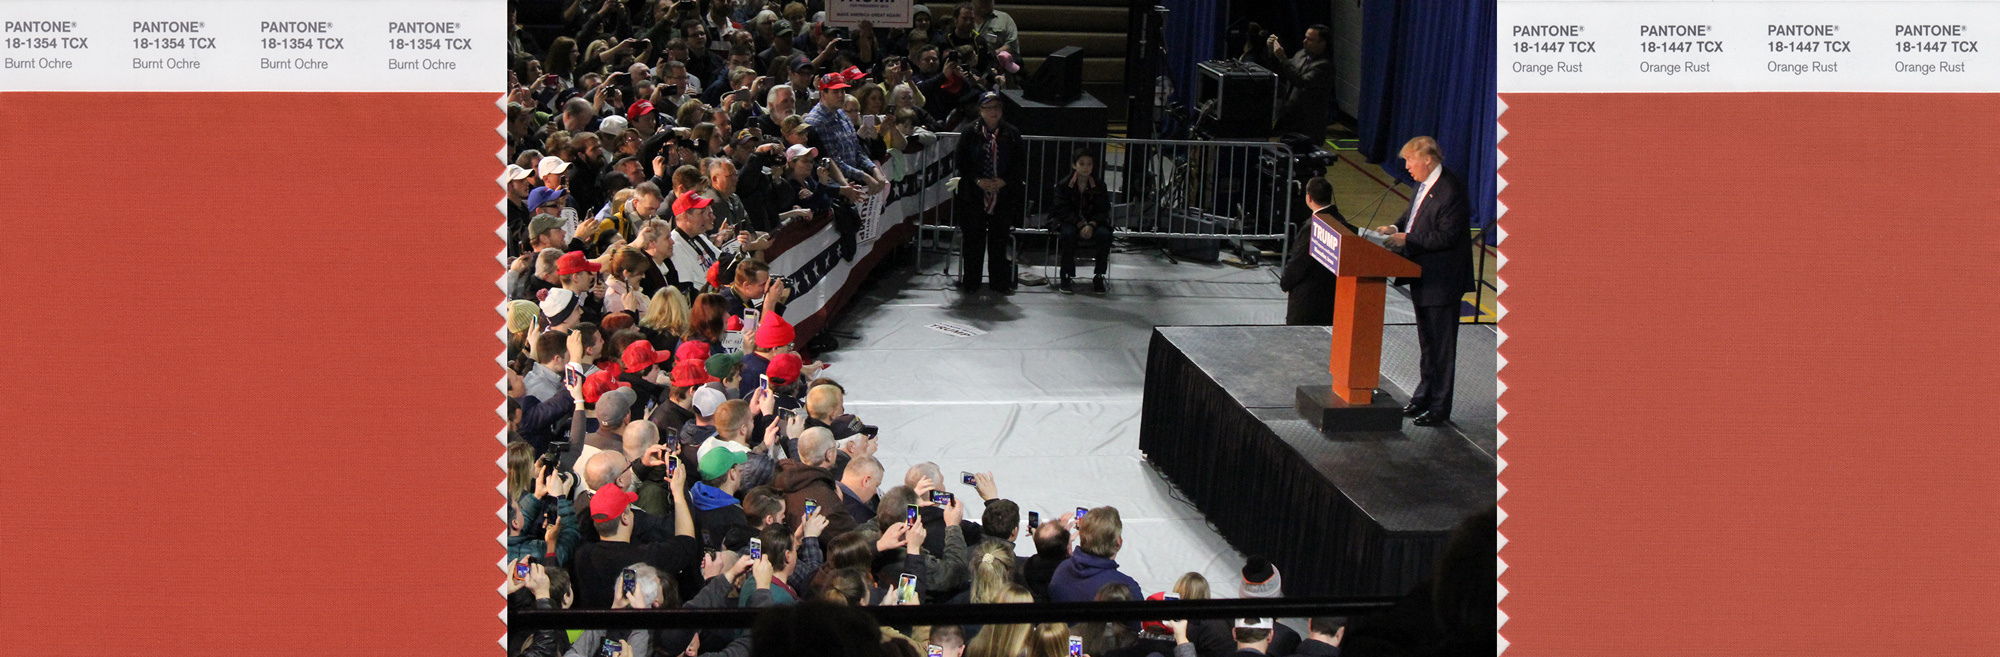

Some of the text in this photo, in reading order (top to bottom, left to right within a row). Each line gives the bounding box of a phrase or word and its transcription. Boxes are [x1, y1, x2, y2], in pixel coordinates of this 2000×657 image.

[5, 37, 88, 49] 18-1354 TCX
[133, 37, 216, 49] 18-1354 TCX
[261, 38, 344, 50] 18-1354 TCX
[389, 38, 472, 50] 18-1354 TCX
[1513, 41, 1596, 53] 18-1447 TCX
[1641, 41, 1724, 53] 18-1447 TCX
[1768, 41, 1851, 53] 18-1447 TCX
[1896, 41, 1979, 53] 18-1447 TCX
[5, 57, 72, 68] Burnt Ochre
[133, 58, 200, 69] Burnt Ochre
[261, 58, 328, 69] Burnt Ochre
[389, 59, 456, 70] Burnt Ochre
[1512, 61, 1582, 75] Orange Rust
[1640, 61, 1710, 75] Orange Rust
[1767, 61, 1837, 75] Orange Rust
[1895, 61, 1965, 75] Orange Rust
[859, 197, 870, 241] RUMP
[1313, 221, 1339, 251] TRUMP
